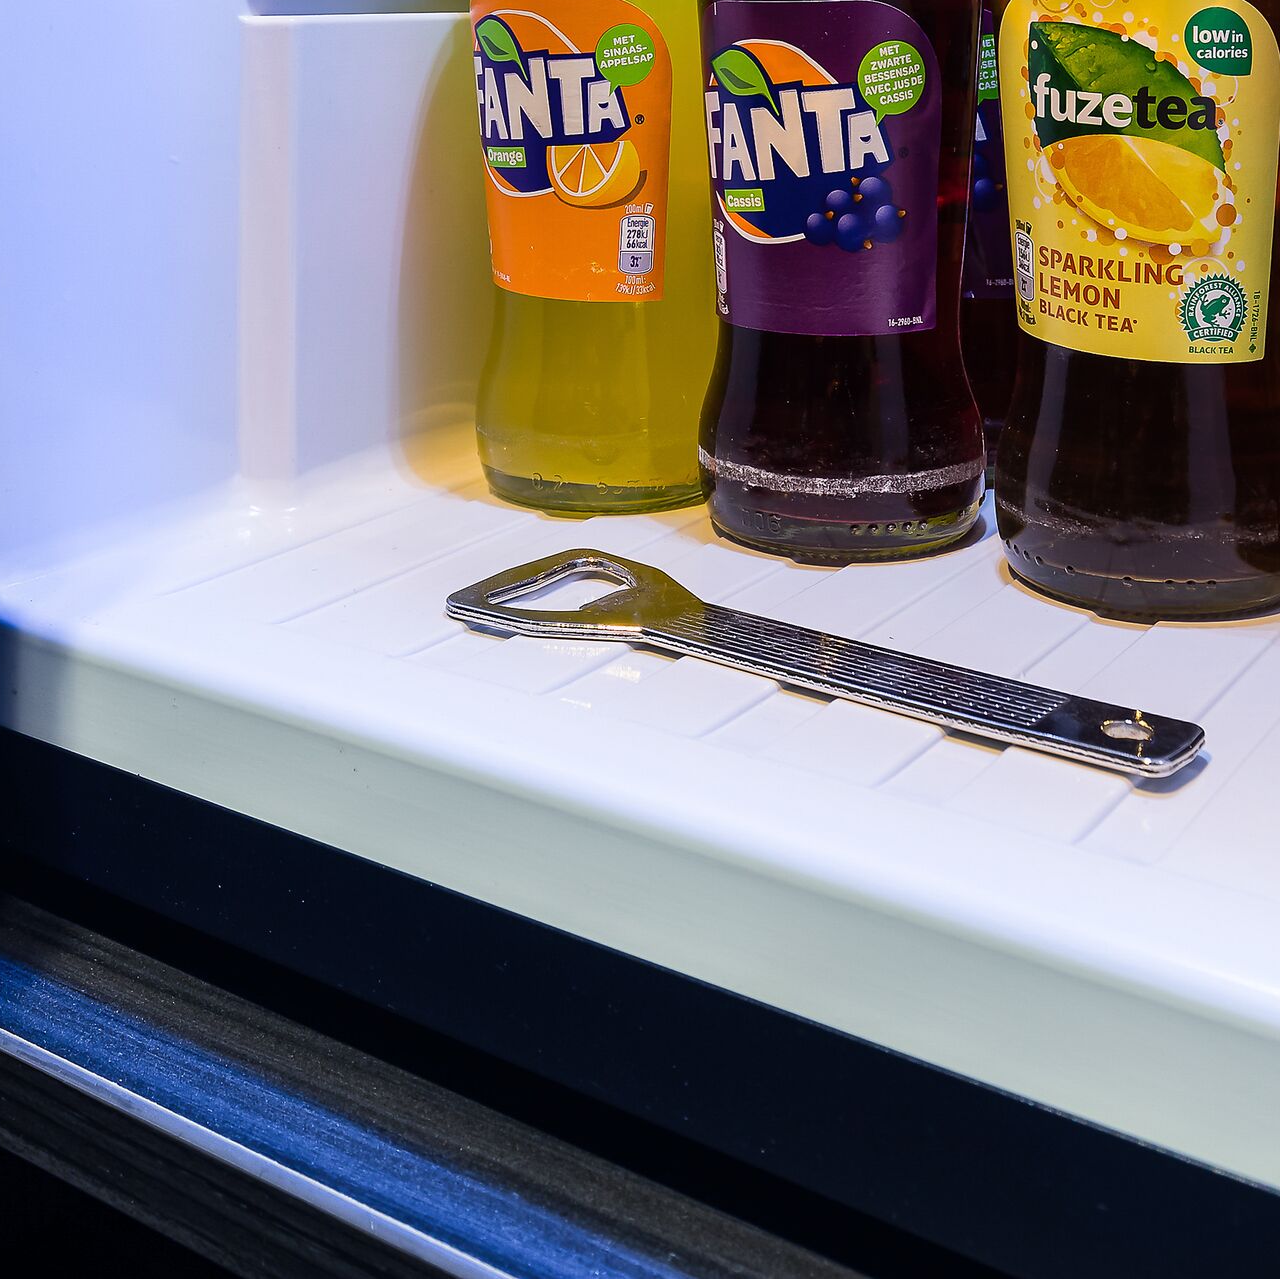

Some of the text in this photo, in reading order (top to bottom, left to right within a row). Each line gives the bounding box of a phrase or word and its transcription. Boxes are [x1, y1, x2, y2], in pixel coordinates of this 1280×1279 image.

[612, 34, 636, 46] MET
[1192, 25, 1244, 44] low in
[603, 44, 648, 58] SINAAS-
[879, 44, 900, 57] MET
[1196, 46, 1248, 59] calories
[599, 53, 654, 69] APPELSAP
[870, 54, 912, 71] ZWARTE
[864, 64, 920, 84] BESSENSAP
[865, 75, 923, 96] AVEC JUS DE
[879, 89, 914, 105] CASSIS
[704, 88, 890, 181] FANTA
[487, 148, 524, 166] Orange
[727, 194, 762, 208] Cassis
[627, 217, 649, 230] Energie
[1039, 245, 1184, 286] SPARKLING
[1039, 272, 1121, 310] LEMON
[1188, 282, 1242, 317] RAINFOREST ALLIANCE
[1039, 298, 1089, 327] BLACK
[1193, 328, 1234, 338] CERTIFIED
[1188, 346, 1234, 354] BLACK TEA
